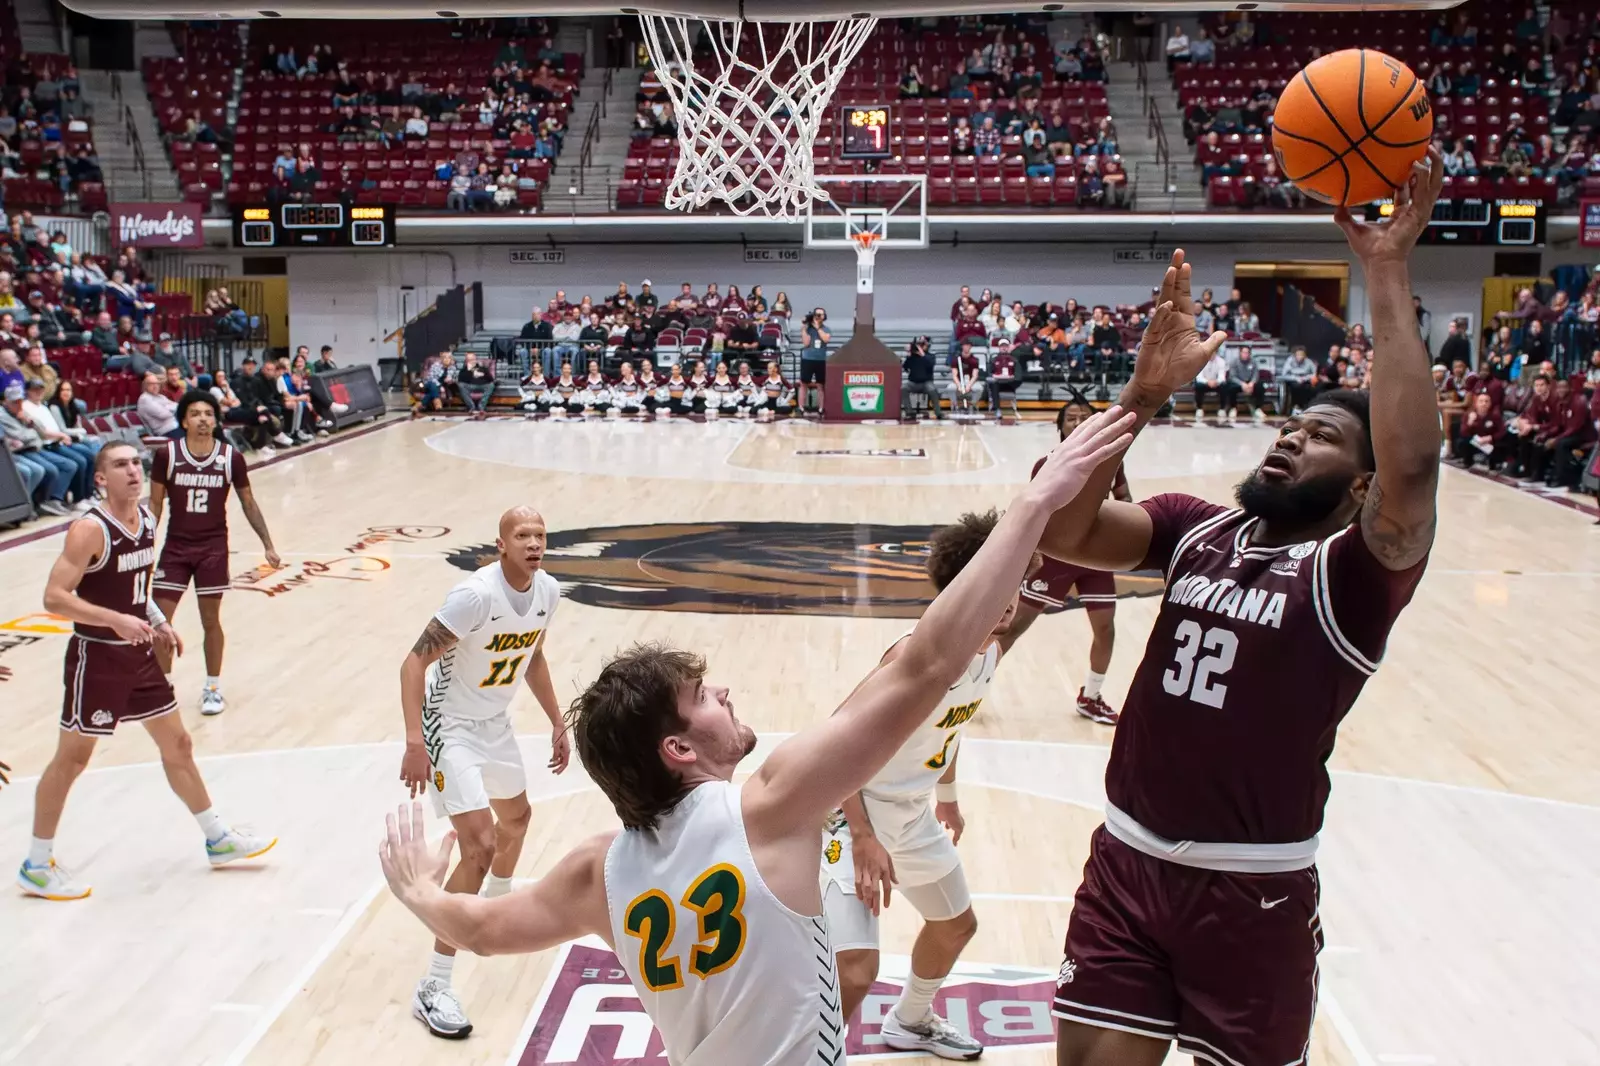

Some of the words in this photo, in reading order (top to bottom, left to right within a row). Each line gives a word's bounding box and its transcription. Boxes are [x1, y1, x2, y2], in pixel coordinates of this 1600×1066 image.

[867, 124, 881, 149] 7
[119, 209, 194, 242] Wendy's
[174, 472, 224, 488] MONTANA
[186, 489, 209, 513] 12
[132, 570, 146, 606] 11
[1167, 571, 1288, 629] MONTANA
[483, 628, 542, 653] NDSU
[478, 653, 528, 689] 11
[1162, 619, 1240, 710] 32
[623, 862, 748, 993] 23
